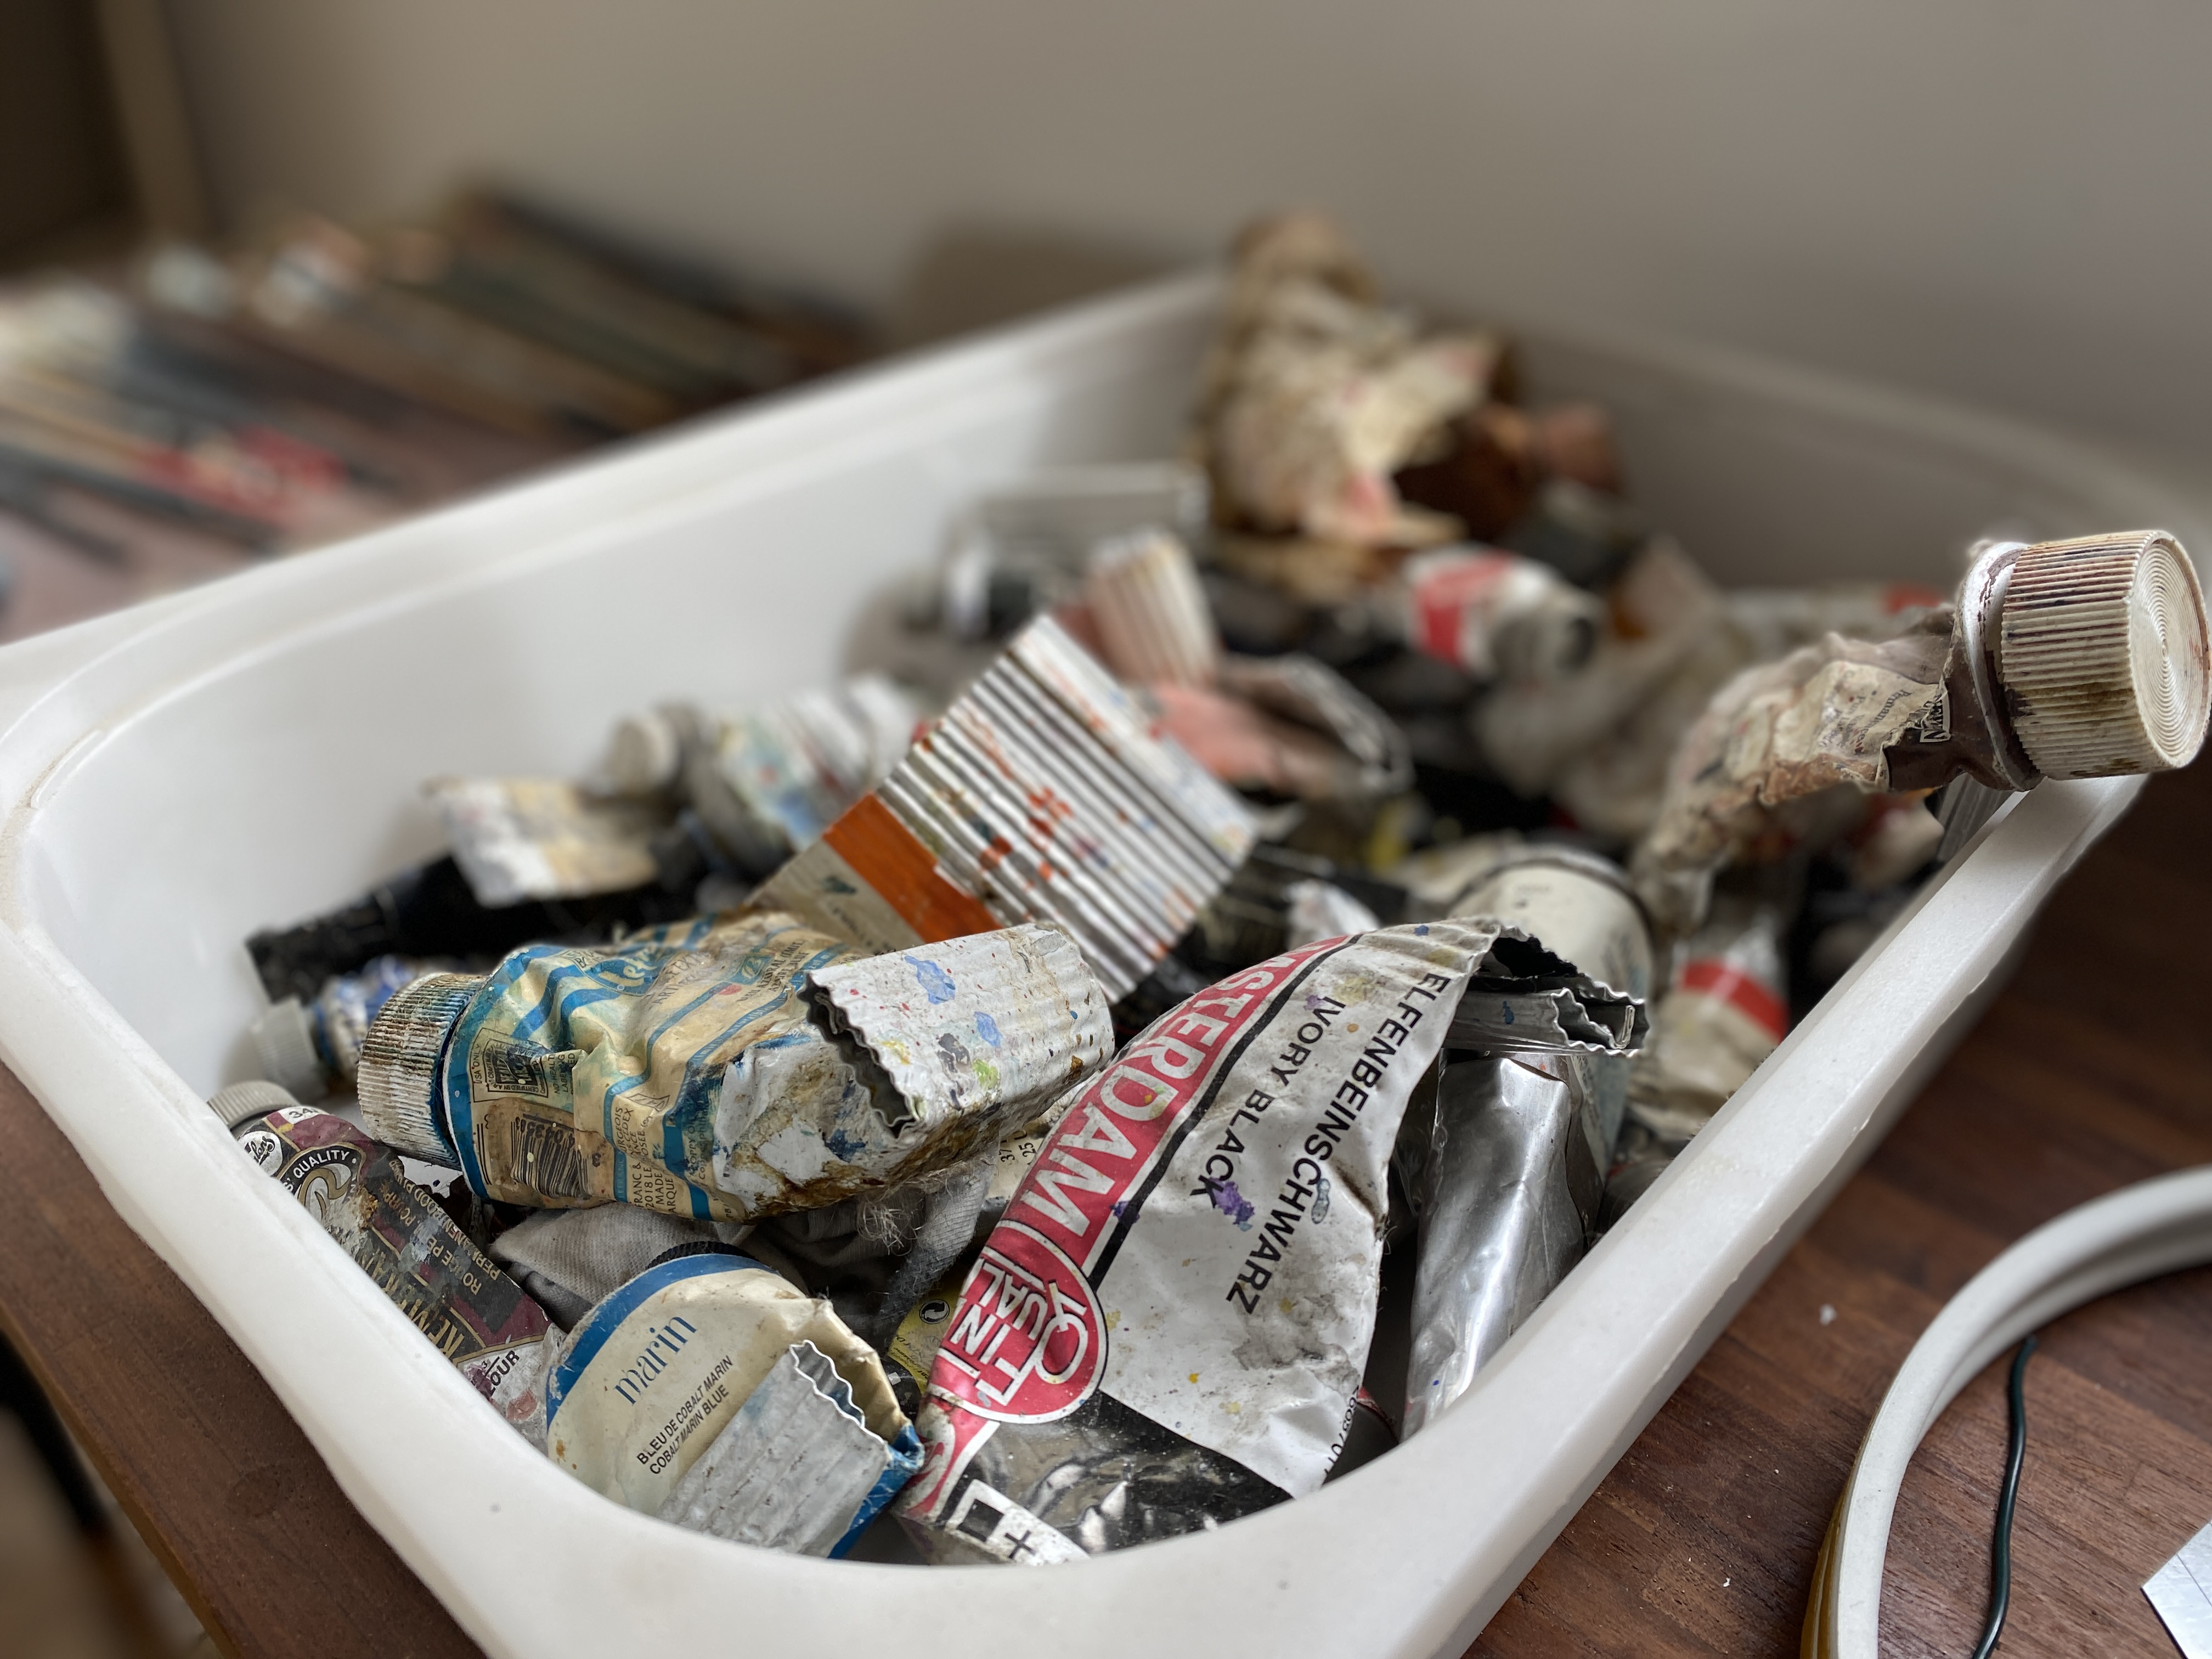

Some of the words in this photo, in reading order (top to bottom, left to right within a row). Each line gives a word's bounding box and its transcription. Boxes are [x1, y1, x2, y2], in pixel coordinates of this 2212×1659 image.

[1271, 996, 1346, 1086] IVORY
[293, 1150, 350, 1179] QUALITY
[1190, 1088, 1271, 1209] BLACK
[1225, 973, 1451, 1314] ELFENBEINSCHWARZ
[654, 1172, 664, 1206] MADE
[613, 1316, 697, 1405] marin
[636, 1431, 667, 1465] BLEU
[664, 1419, 679, 1437] DE
[675, 1385, 704, 1424] COBALT
[703, 1355, 733, 1392] MARIN
[650, 1435, 681, 1475] COBALT
[680, 1409, 704, 1443] MARIN
[702, 1384, 730, 1415] BLUE
